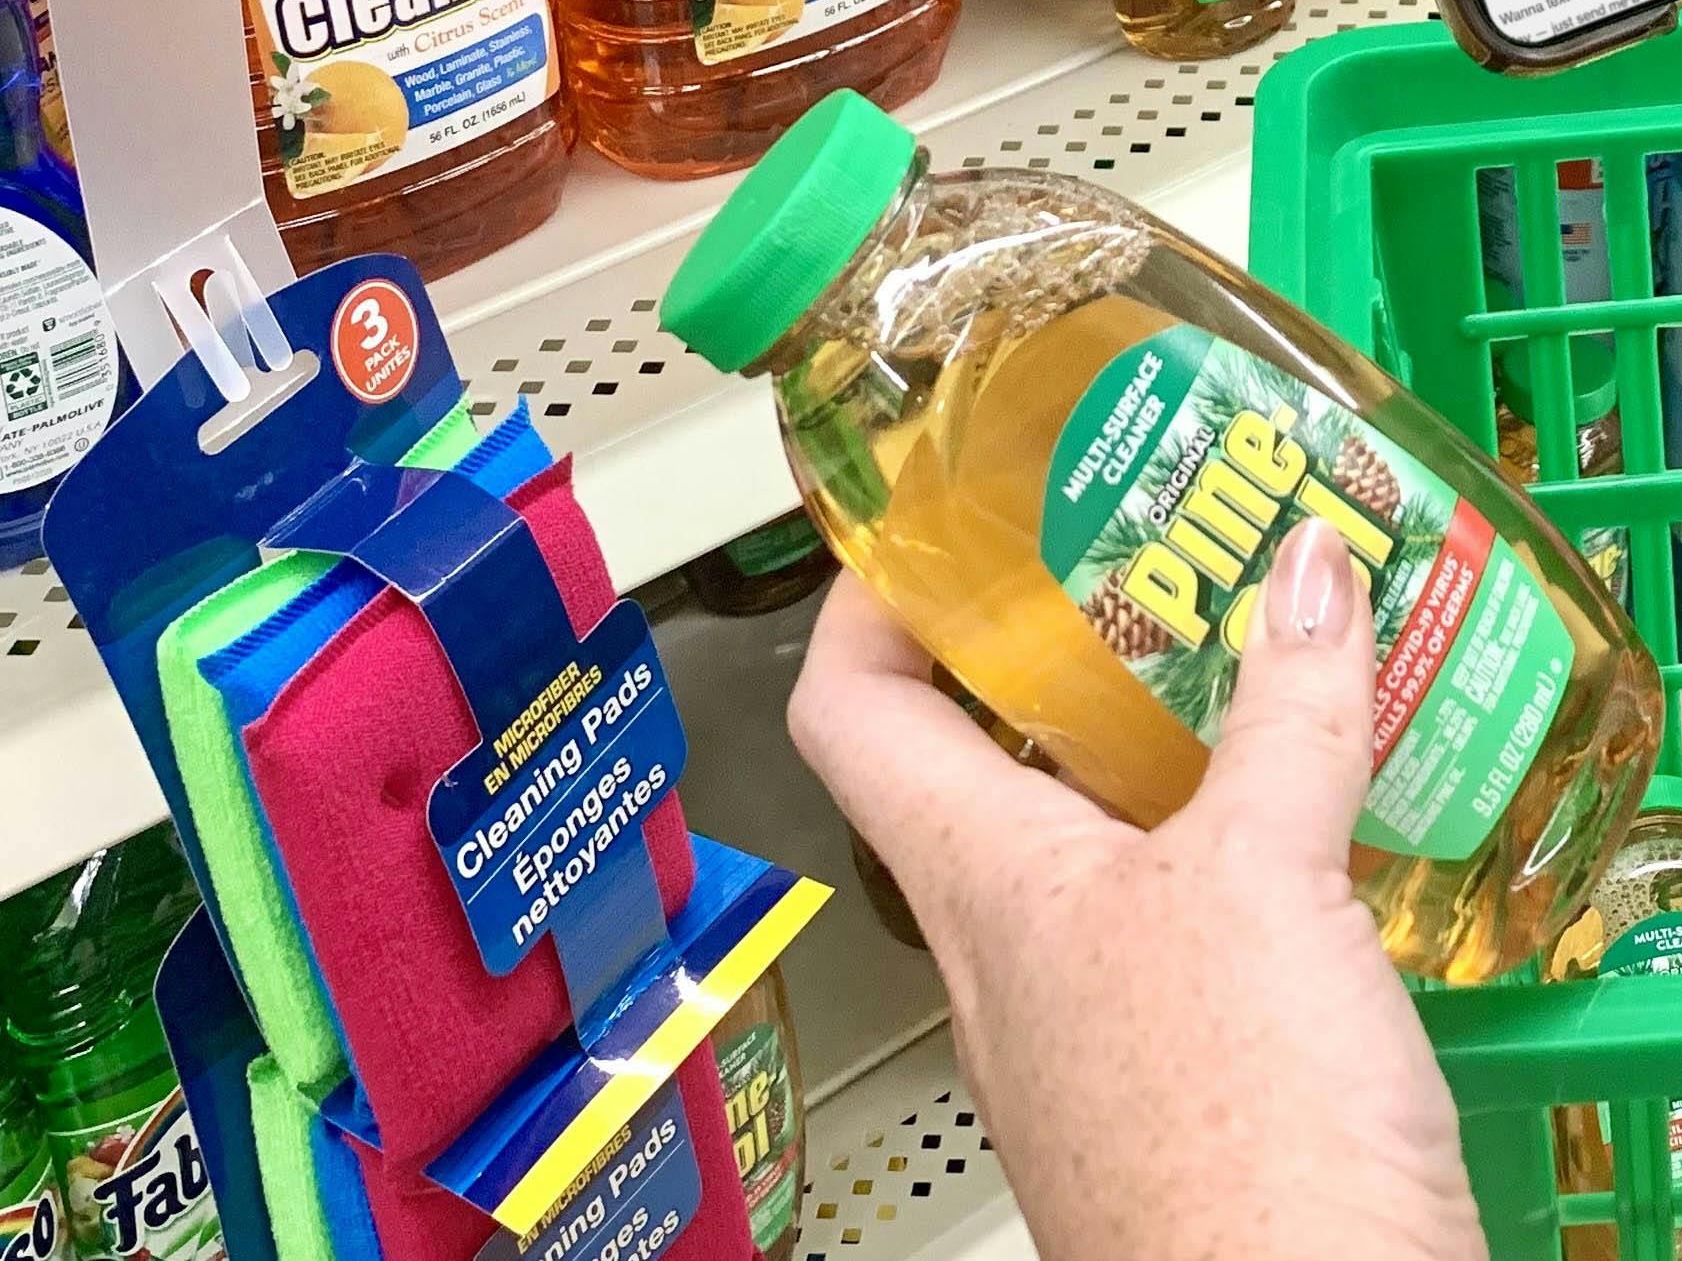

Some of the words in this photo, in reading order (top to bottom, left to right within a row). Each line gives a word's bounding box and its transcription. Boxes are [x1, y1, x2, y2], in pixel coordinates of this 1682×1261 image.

[387, 44, 411, 62] with
[414, 20, 475, 54] Citrus
[403, 68, 440, 89] Wood,
[439, 47, 489, 74] Laminate,
[414, 79, 455, 103] Marble,
[455, 63, 493, 86] Granite,
[423, 88, 476, 117] Porcelain,
[475, 74, 503, 95] Glass
[429, 132, 443, 144] 56
[444, 125, 461, 138] FL.
[462, 114, 480, 130] OZ.
[482, 101, 508, 123] (1656
[350, 298, 388, 350] 3
[364, 333, 401, 372] PACK
[2, 398, 105, 440] ATE-PALMOLIVE
[1061, 350, 1164, 504] MULTI-SURFACE
[1102, 394, 1166, 486] CLEANER
[1148, 424, 1218, 526] ORIGINAL
[1116, 405, 1309, 650] Pine-
[1373, 700, 1408, 752] KILLS
[1401, 651, 1435, 704] 99.9%
[1427, 621, 1448, 653] OF
[1385, 612, 1435, 688] COVID-19
[483, 761, 511, 796] EN
[508, 664, 603, 770] MICROFIBRES
[492, 660, 582, 759] MICROFIBER
[456, 739, 583, 879] Cleaning
[581, 663, 652, 745] Pads
[1472, 783, 1499, 820] 9.5
[511, 764, 667, 946] nettoyantes
[512, 757, 632, 895] Éponges
[517, 1227, 540, 1255] EN
[541, 1123, 633, 1229] MICROFIBRES
[608, 1117, 677, 1199] Pads
